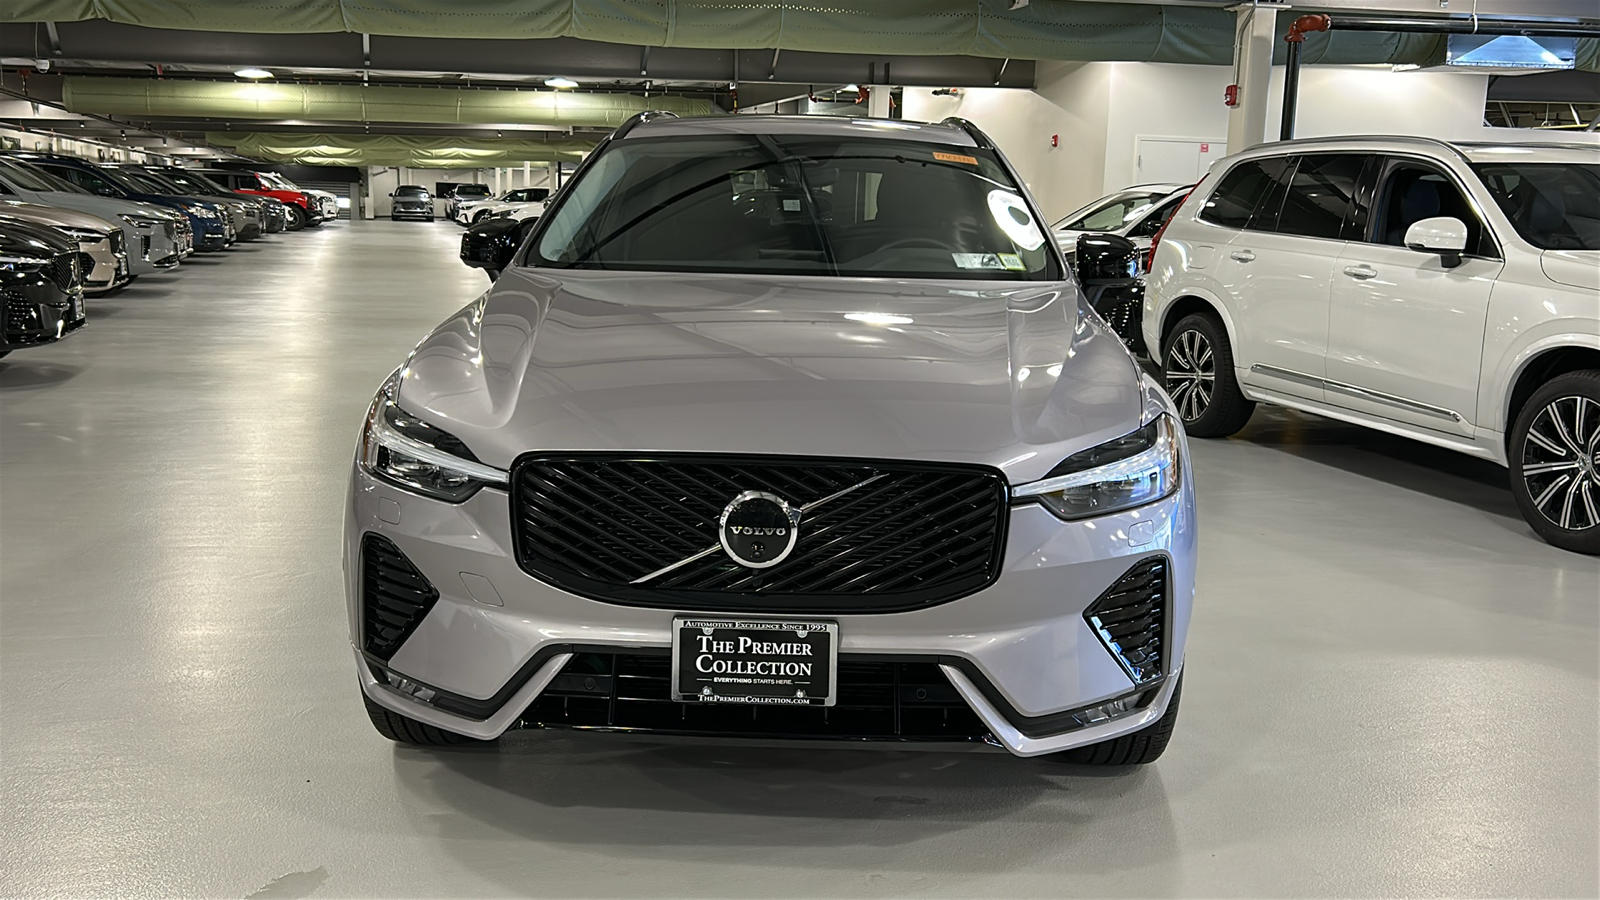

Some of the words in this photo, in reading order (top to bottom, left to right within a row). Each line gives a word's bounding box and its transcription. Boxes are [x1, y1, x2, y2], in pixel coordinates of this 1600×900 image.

[730, 526, 786, 536] VOLVO
[685, 621, 734, 629] AUTOMOTIVE
[735, 622, 780, 630] EXCELLENCE
[781, 623, 804, 631] SINCE
[696, 635, 735, 654] THE
[737, 636, 813, 656] PREMIER
[695, 654, 813, 676] COLLECTION
[698, 694, 810, 705] THEPREMIERCOLLECTION.COM
